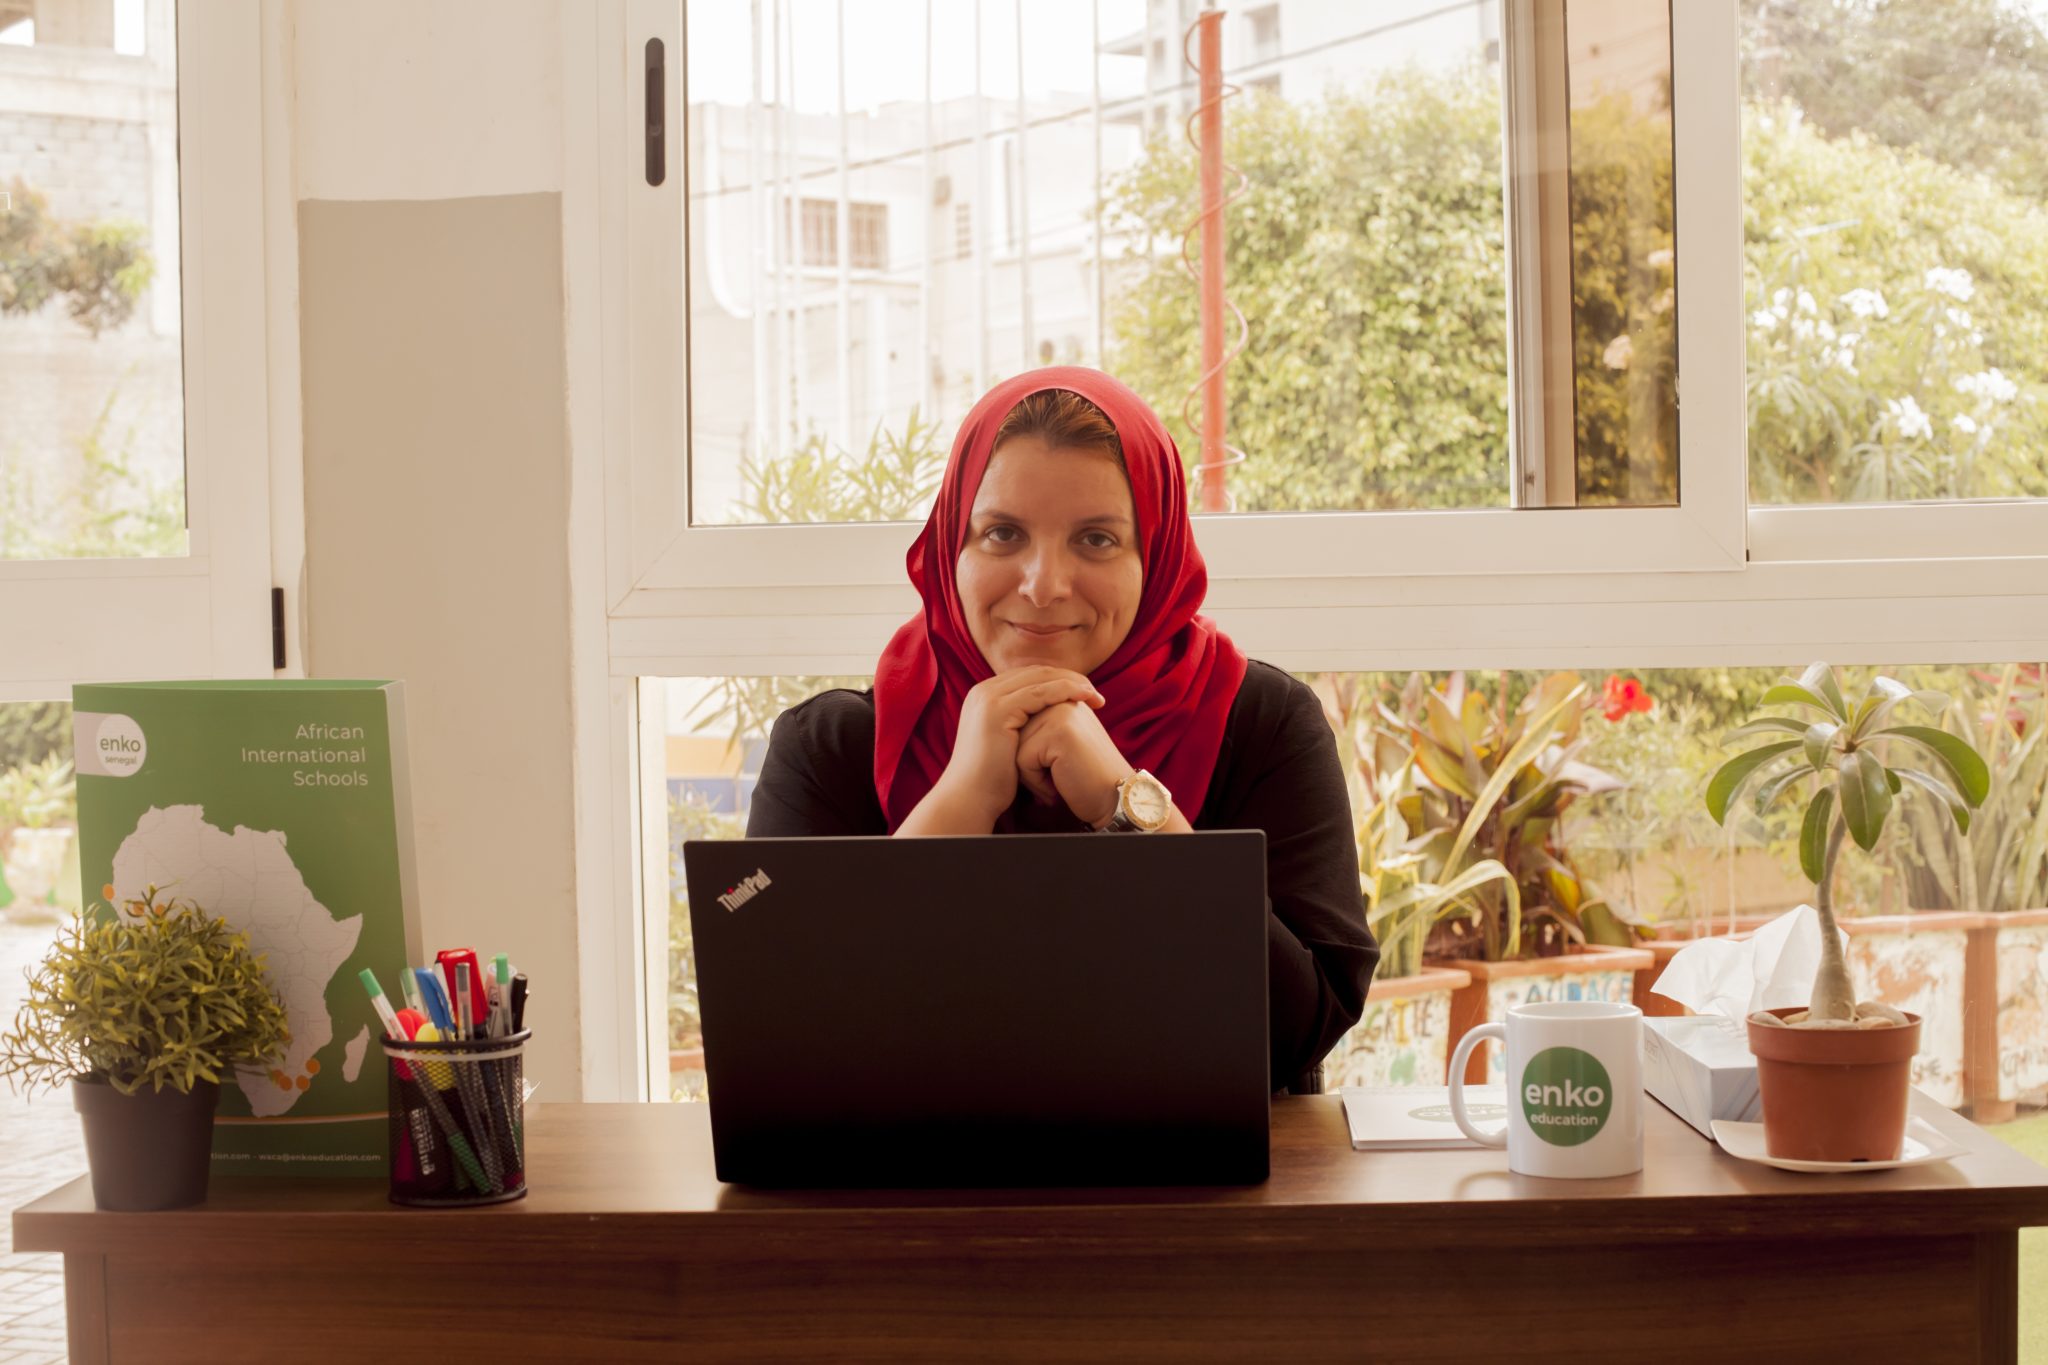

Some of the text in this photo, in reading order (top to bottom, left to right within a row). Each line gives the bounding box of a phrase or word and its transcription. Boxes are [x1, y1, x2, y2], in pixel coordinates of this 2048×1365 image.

[295, 723, 364, 740] African
[100, 734, 141, 753] enko
[241, 747, 366, 763] International
[293, 769, 369, 787] Schools
[716, 867, 773, 913] ThinkPad
[1525, 1078, 1605, 1108] enko
[1530, 1112, 1599, 1127] education
